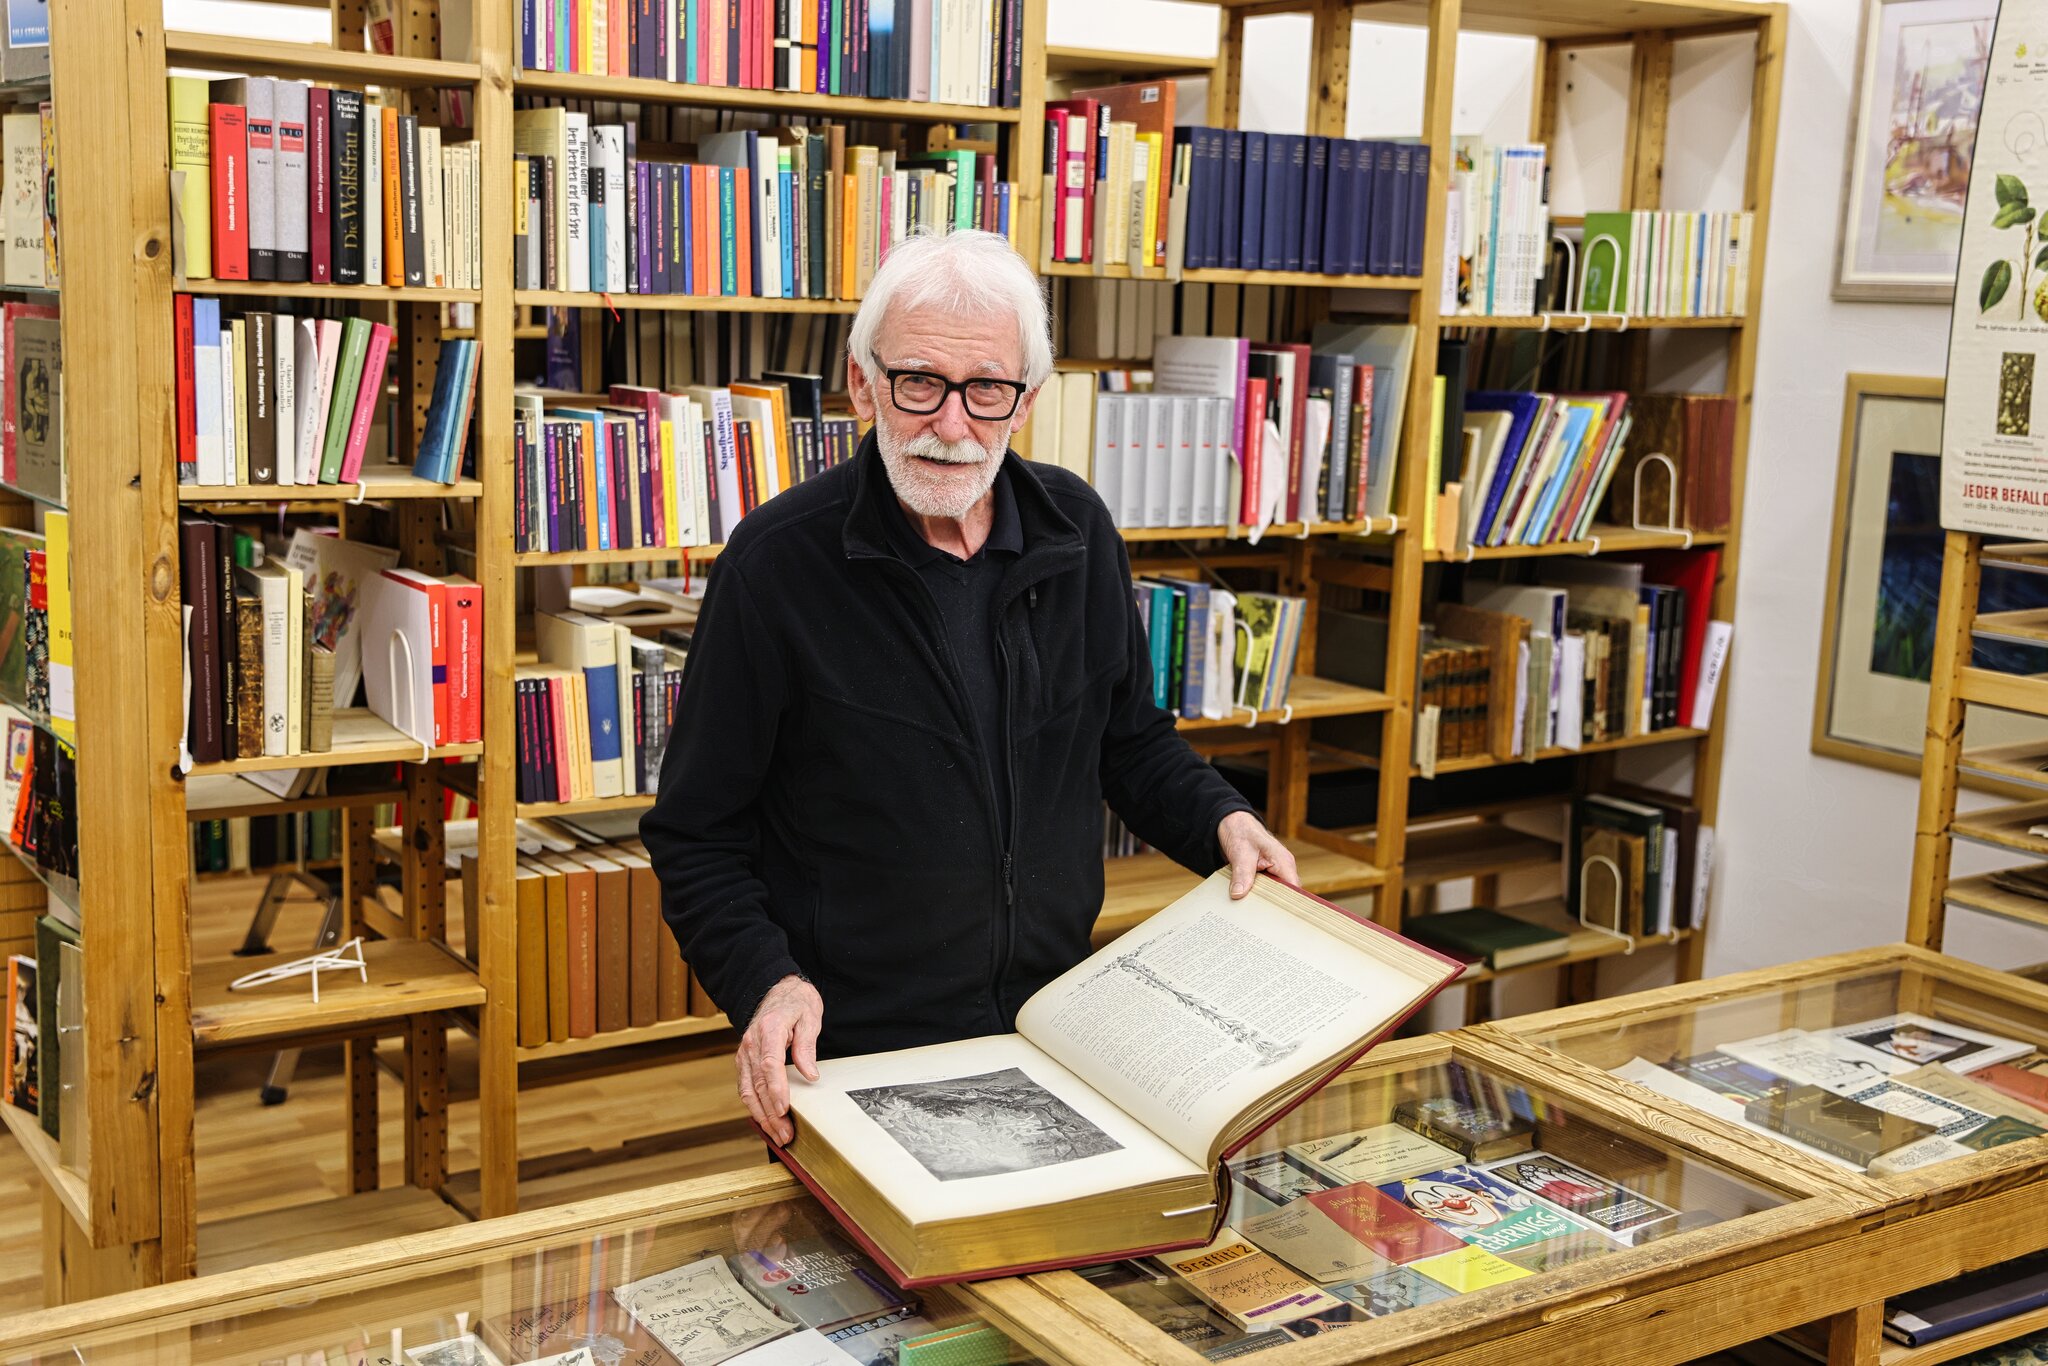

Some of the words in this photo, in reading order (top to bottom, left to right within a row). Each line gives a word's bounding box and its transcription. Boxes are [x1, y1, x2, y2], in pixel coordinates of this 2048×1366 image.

[1099, 106, 1110, 137] Karma
[567, 127, 579, 146] Dem
[568, 149, 579, 182] Denken
[580, 141, 588, 167] Howard
[227, 155, 235, 196] Psychotherapie
[340, 132, 358, 220] Wolfsfrau
[580, 168, 588, 196] Gardner
[567, 184, 579, 199] auf
[724, 182, 732, 203] Praxis
[568, 202, 580, 216] der
[629, 202, 637, 227] Negro!
[724, 204, 732, 214] und
[344, 221, 357, 249] Die
[569, 218, 580, 240] Spur
[724, 216, 733, 238] Theorie
[725, 240, 733, 272] Habermas
[862, 253, 870, 267] Der
[726, 272, 734, 292] Jürgen
[1962, 483, 1998, 499] JEDER
[2002, 487, 2040, 506] BEFALL
[460, 619, 468, 652] Wörterbuch
[460, 654, 469, 698] Österreichisches
[776, 1252, 829, 1269] KLEINE
[1176, 1248, 1236, 1273] Graffiti
[1237, 1244, 1252, 1253] 2
[795, 1264, 857, 1282] GROSSER
[650, 1312, 670, 1321] Ein
[672, 1304, 704, 1316] Sang
